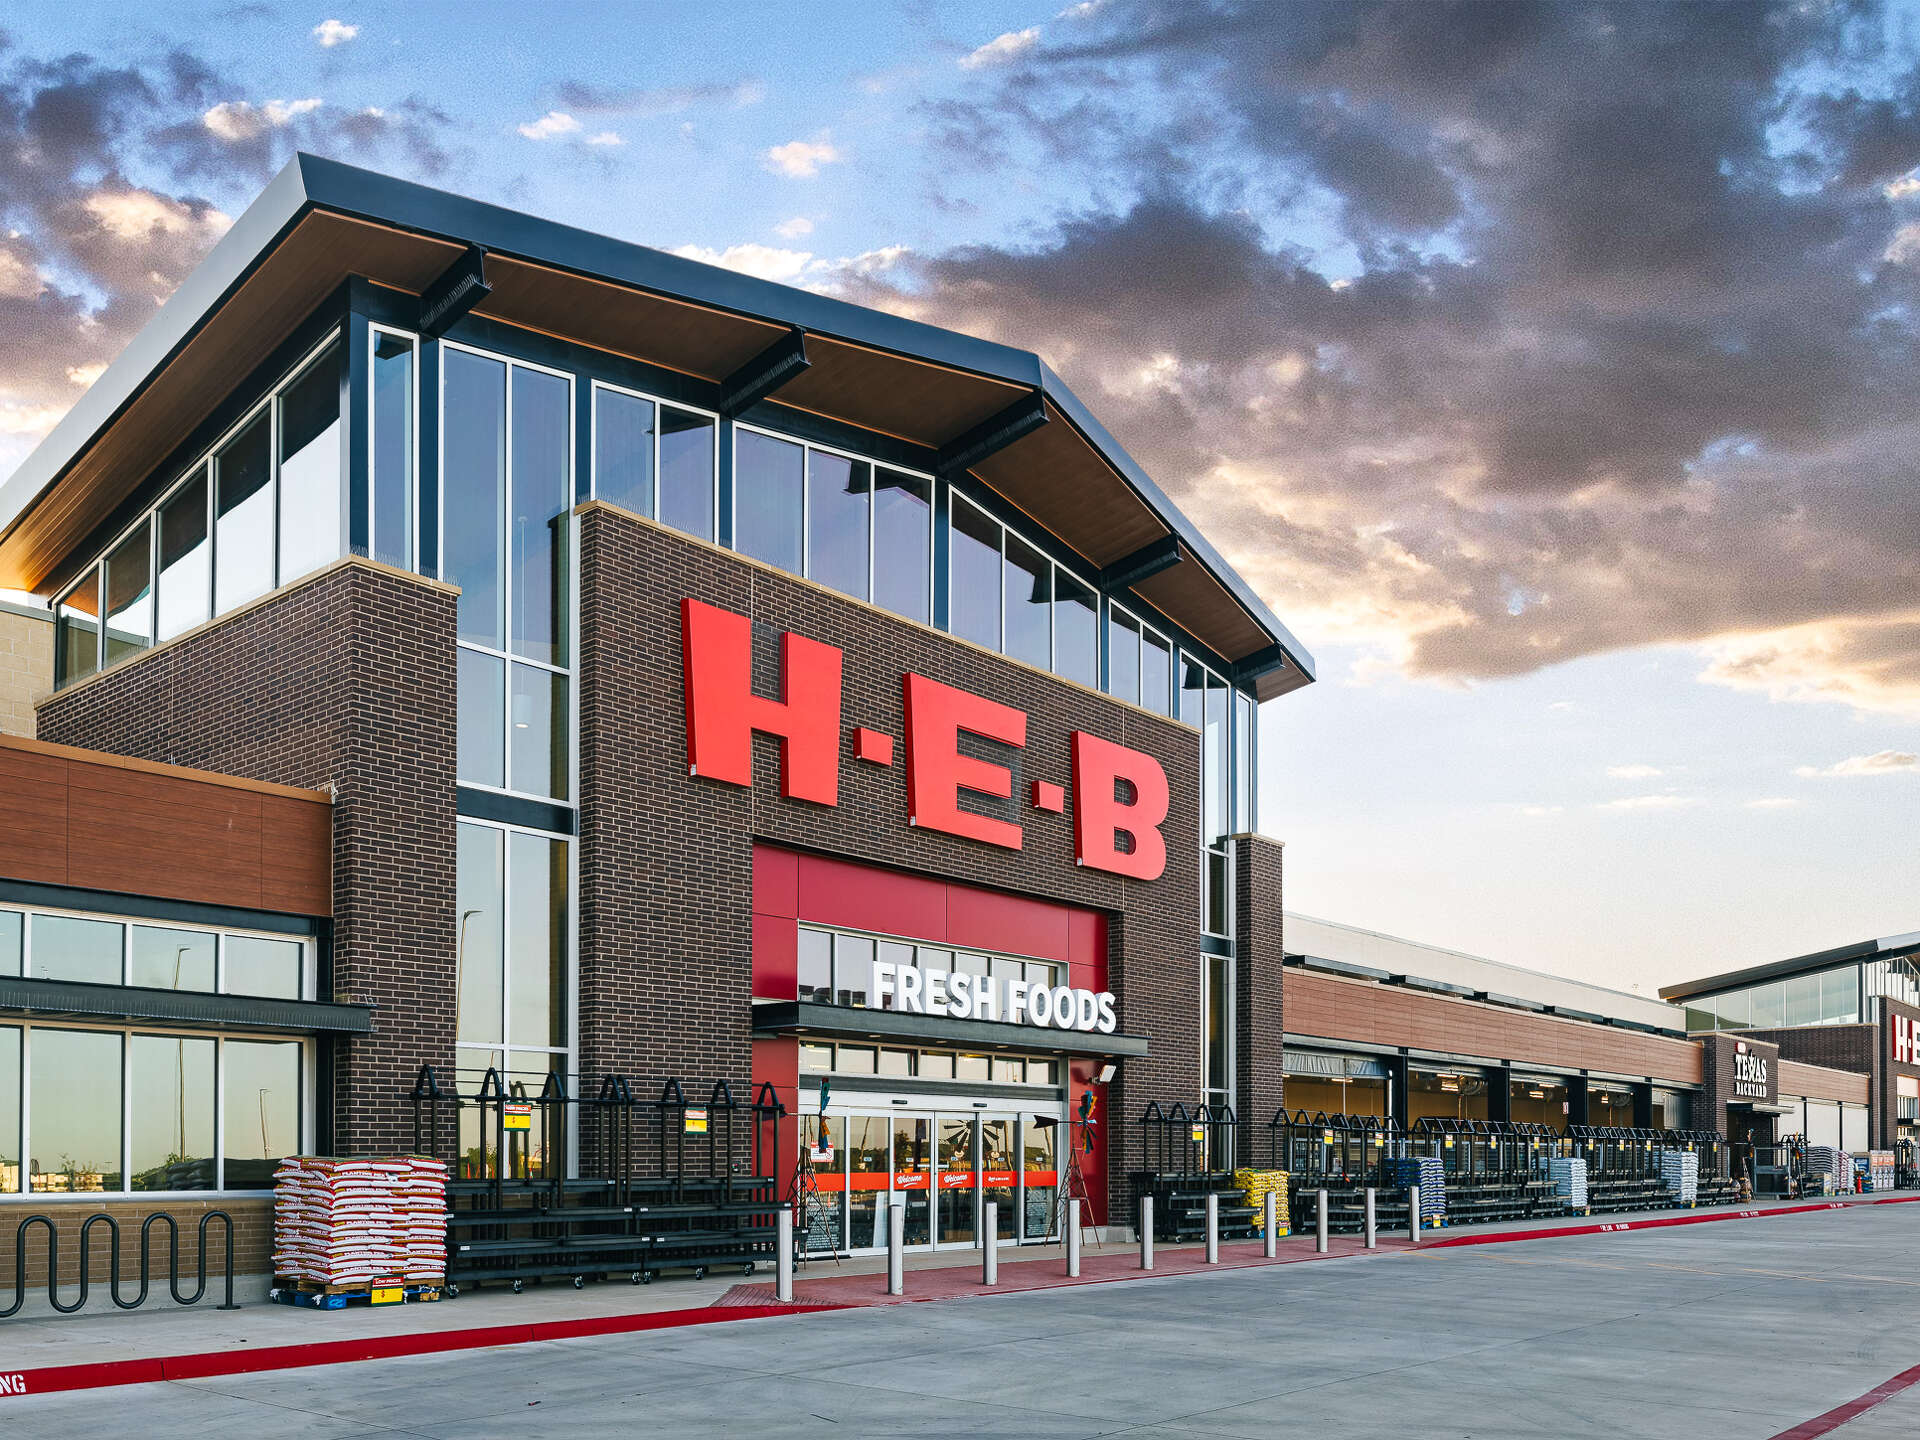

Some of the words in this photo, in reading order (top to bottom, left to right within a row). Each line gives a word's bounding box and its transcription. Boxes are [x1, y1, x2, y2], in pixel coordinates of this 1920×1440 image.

[872, 960, 997, 1021] FRESH
[1002, 979, 1117, 1034] FOODS
[1735, 1050, 1767, 1084] TEXAS
[1735, 1081, 1768, 1098] BACKYARD
